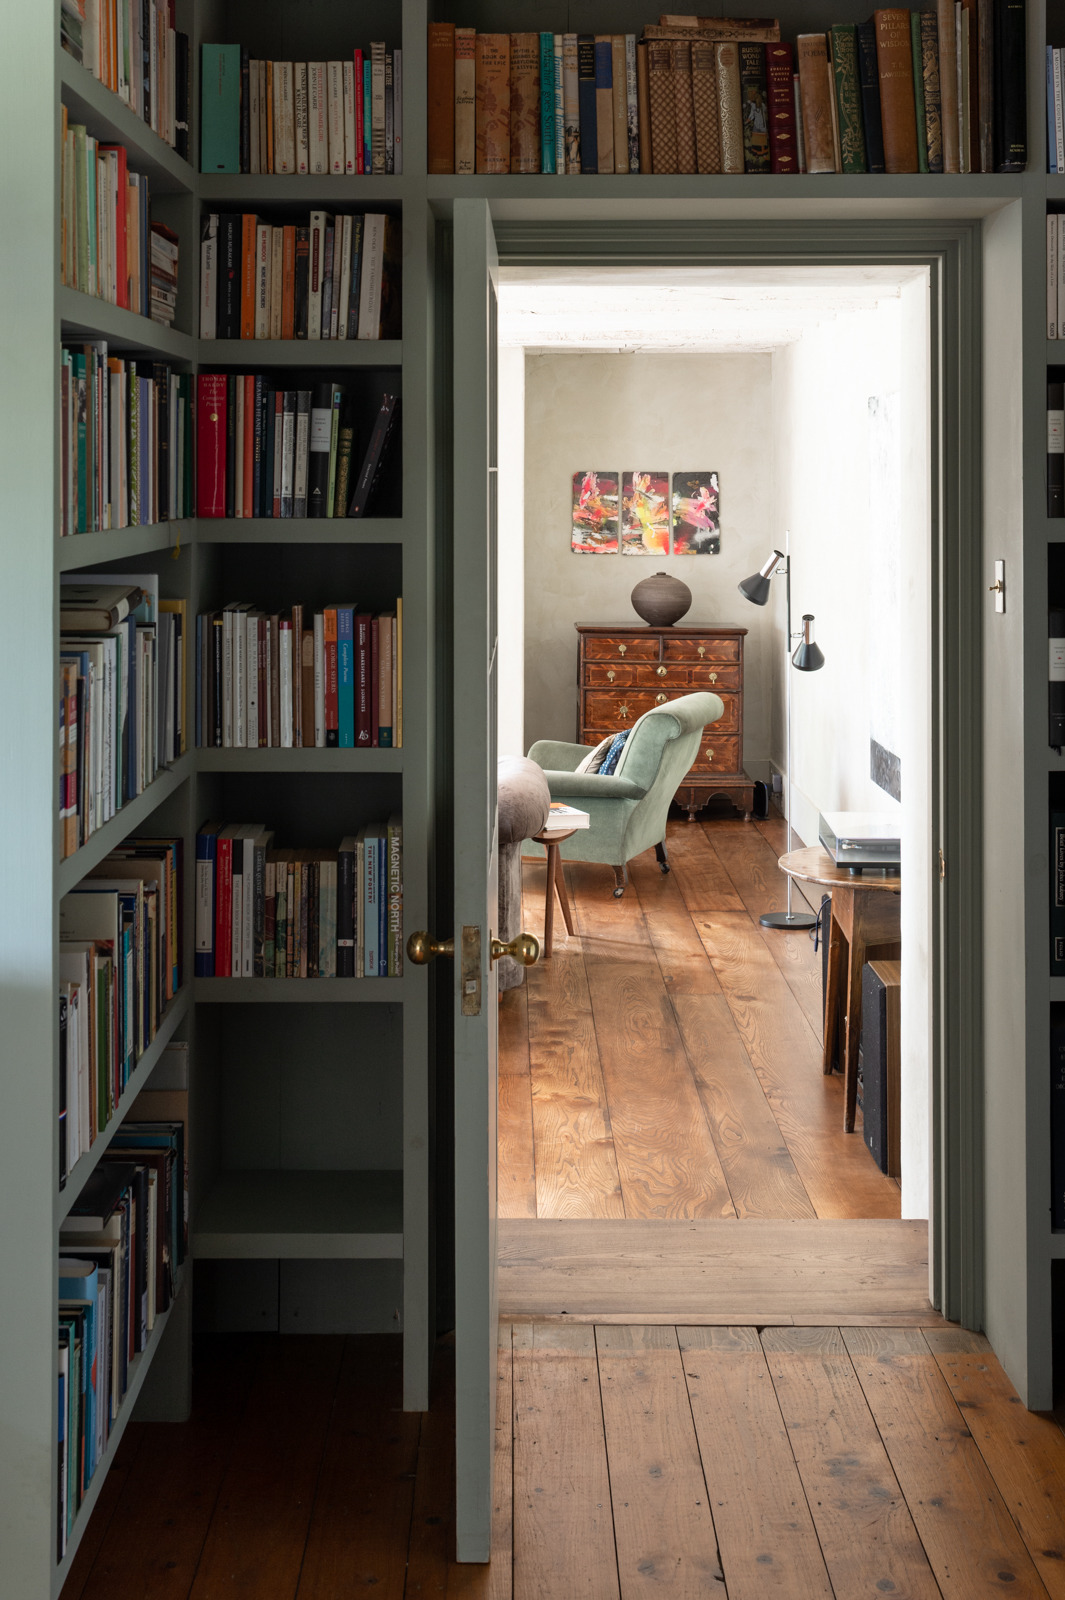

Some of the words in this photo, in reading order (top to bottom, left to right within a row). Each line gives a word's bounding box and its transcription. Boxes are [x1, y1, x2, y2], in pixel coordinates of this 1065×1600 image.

[882, 13, 906, 21] SEVEN
[543, 48, 554, 86] Mischief
[554, 56, 563, 90] Triumph
[543, 90, 554, 112] goes
[554, 93, 563, 110] and
[543, 114, 554, 146] South
[555, 114, 564, 159] Tribulation
[386, 633, 390, 644] NO
[391, 837, 399, 892] MAGNETIC
[391, 896, 399, 932] NORTH
